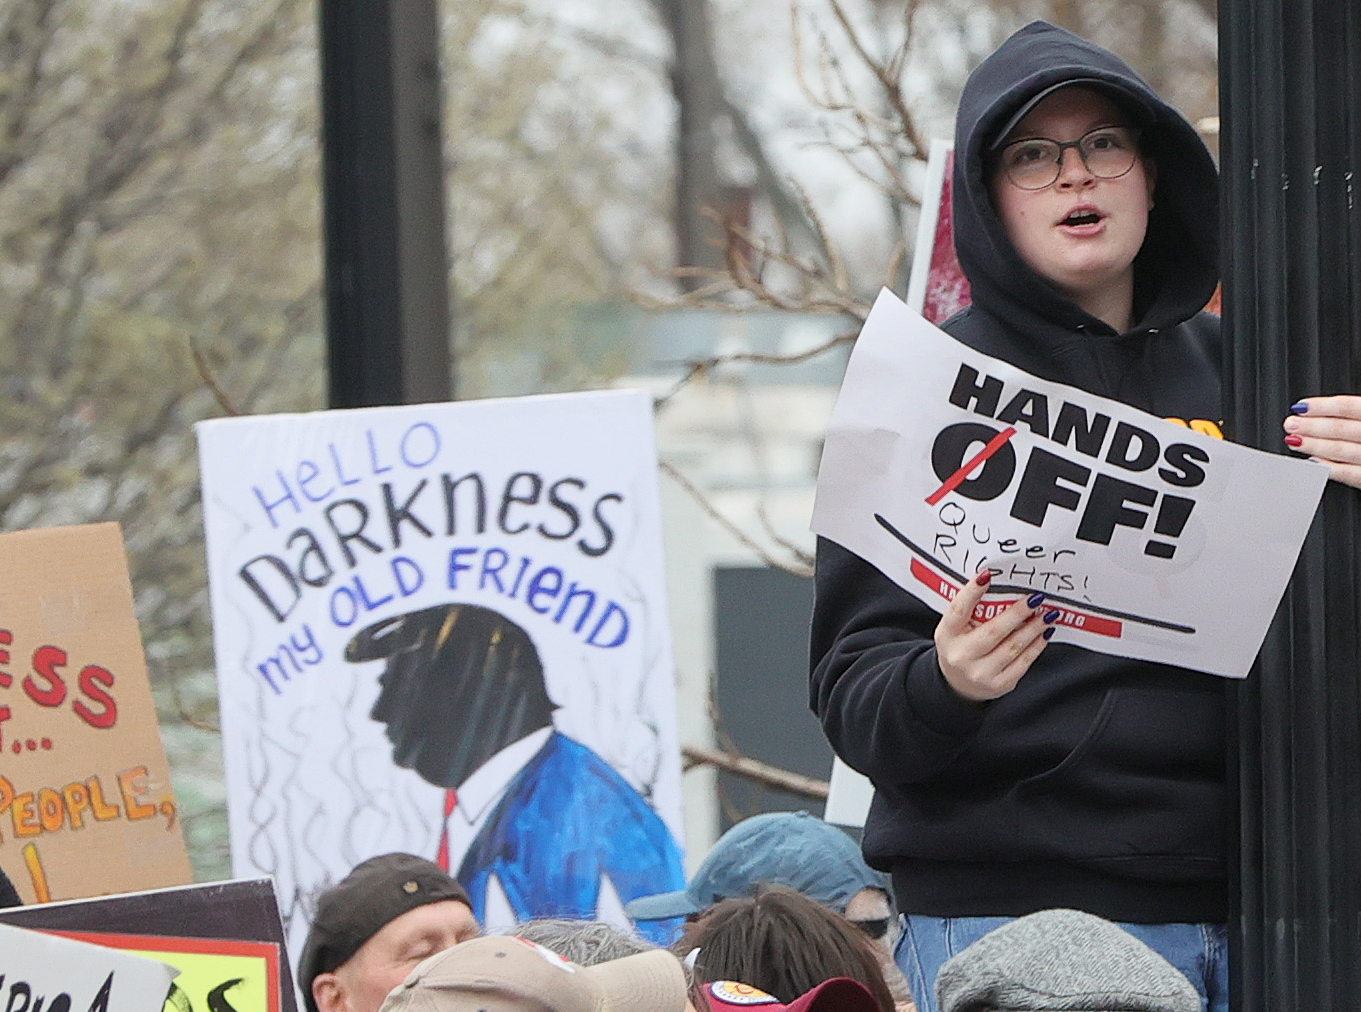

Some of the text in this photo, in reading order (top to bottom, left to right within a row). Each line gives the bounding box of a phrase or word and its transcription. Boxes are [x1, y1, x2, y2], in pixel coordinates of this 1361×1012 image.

[948, 363, 1210, 488] HANDS
[931, 422, 1196, 559] OFF!
[329, 557, 425, 628] OLD
[934, 533, 1091, 602] RIGHTS!
